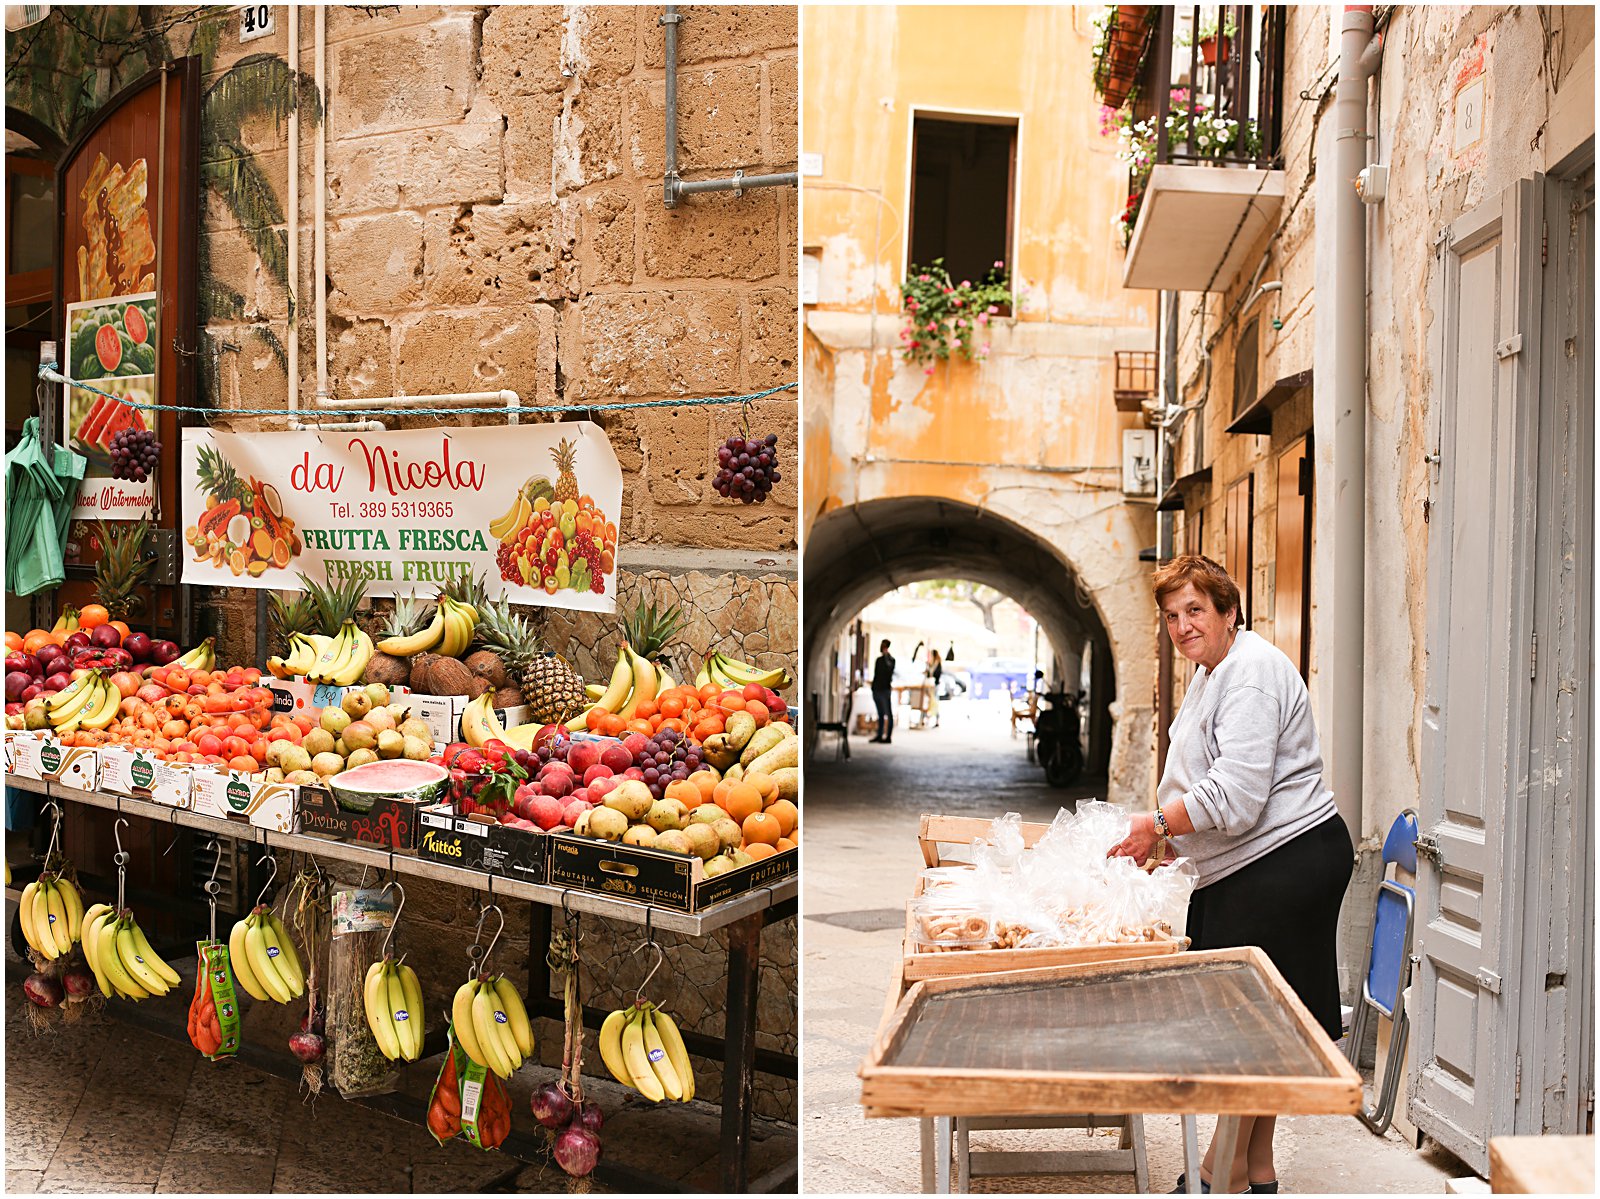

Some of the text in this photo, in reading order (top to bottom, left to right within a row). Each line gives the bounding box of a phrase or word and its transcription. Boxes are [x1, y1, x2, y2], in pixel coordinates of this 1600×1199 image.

[245, 5, 268, 32] 40
[290, 438, 486, 496] da Nicola
[330, 502, 454, 518] Tel. 389 5319365
[302, 529, 488, 551] FRUTTA FRESCA
[323, 559, 471, 582] FRESH FRUIT
[302, 809, 347, 831] Divine
[556, 869, 595, 882] FRUTARIA
[749, 861, 790, 881] FRUTARIA
